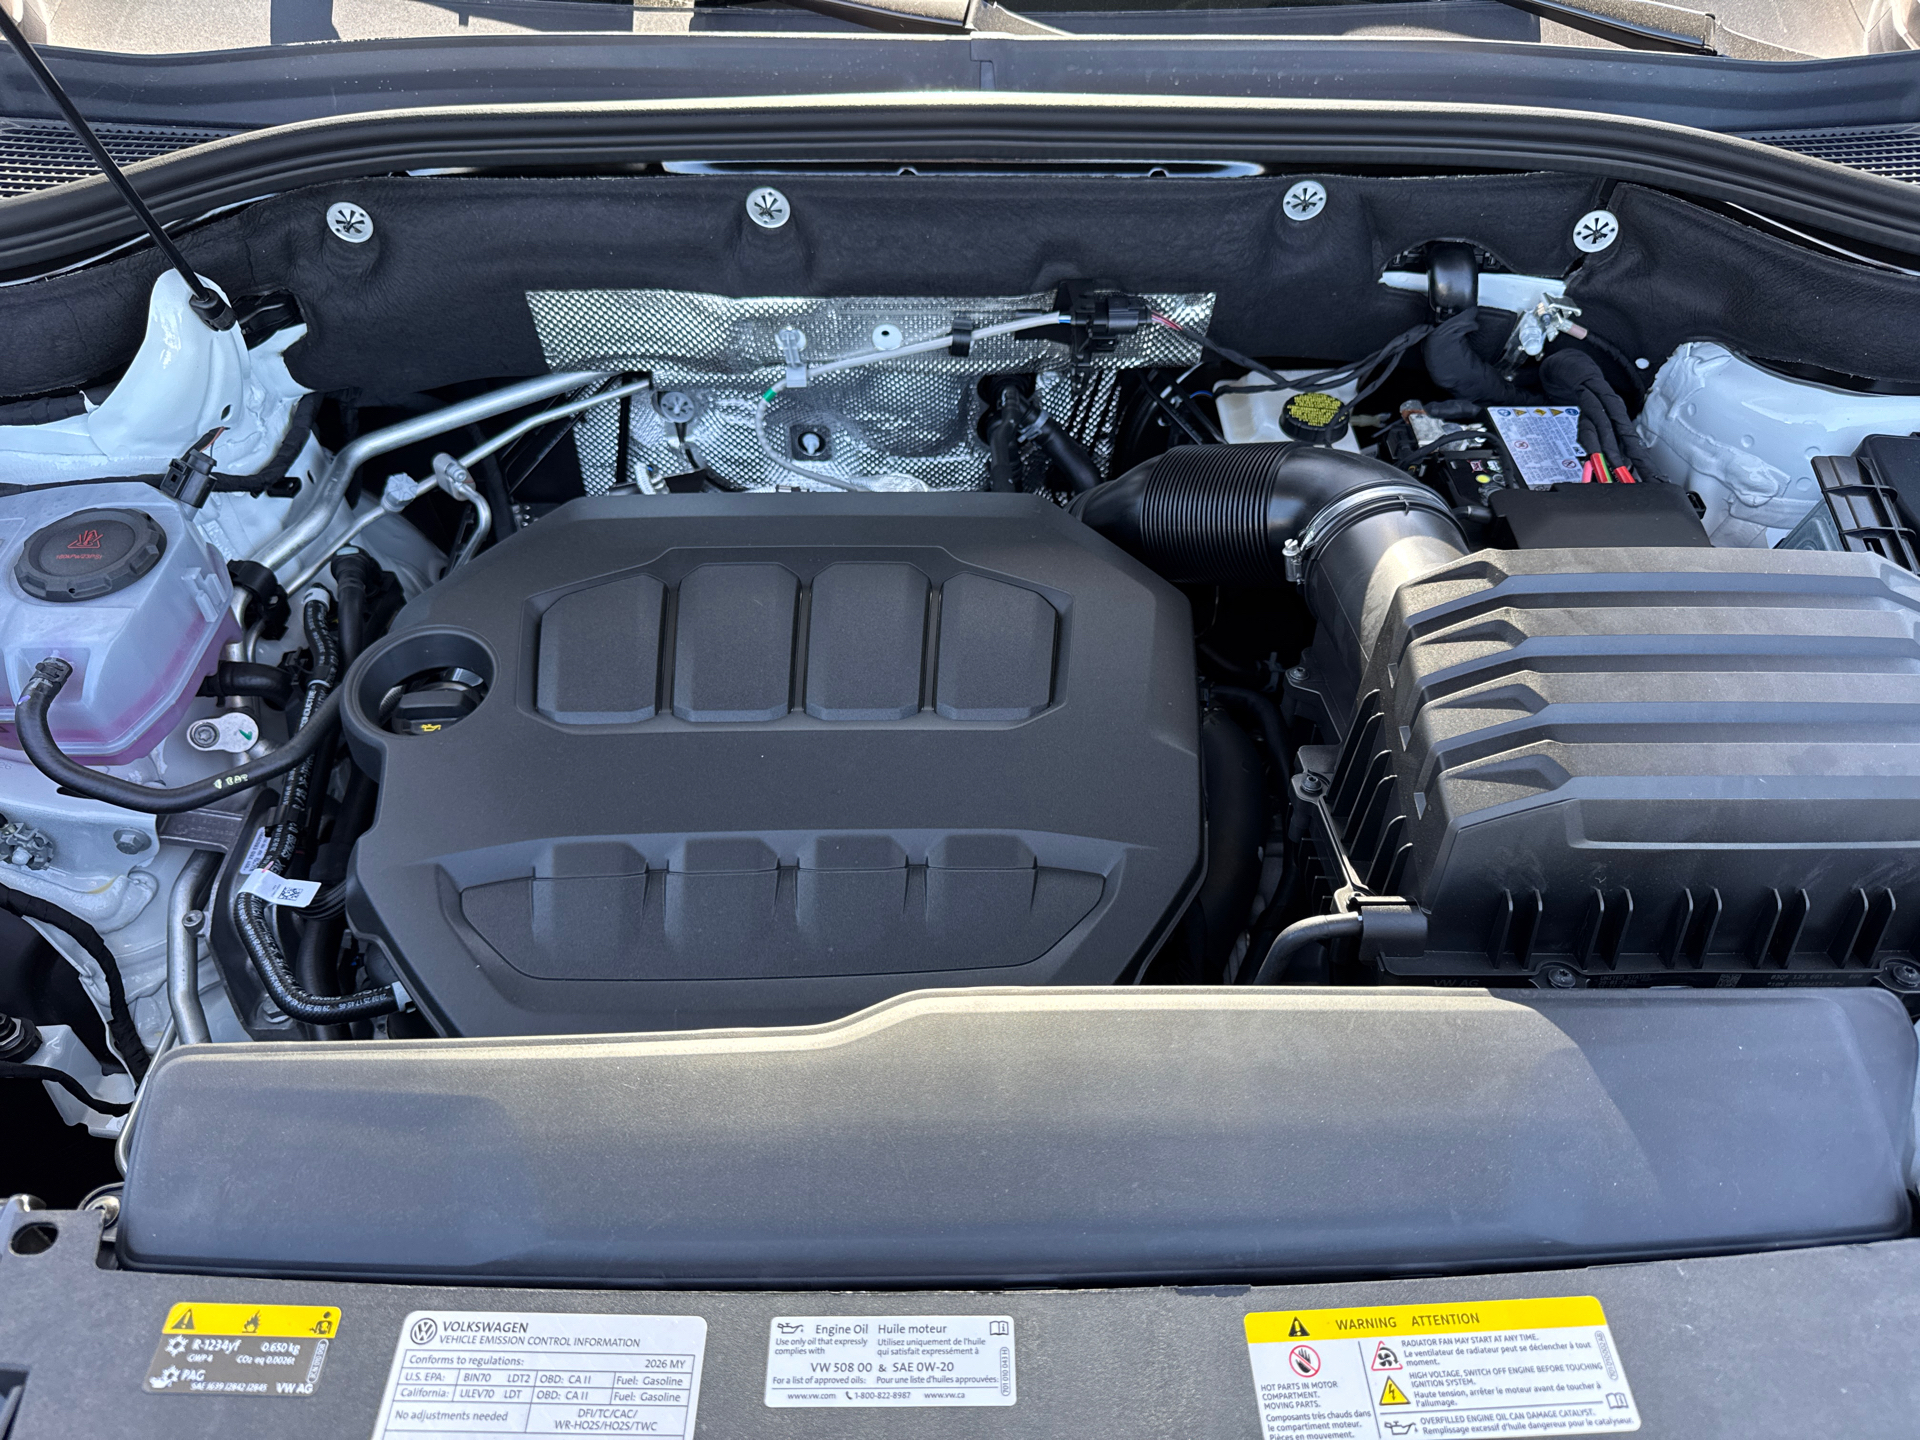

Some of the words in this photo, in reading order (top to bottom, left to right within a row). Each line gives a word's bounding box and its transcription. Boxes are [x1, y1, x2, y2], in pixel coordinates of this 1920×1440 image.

[1434, 979, 1456, 987] VW
[1460, 979, 1480, 987] AG
[1335, 1316, 1397, 1330] WARNING
[1412, 1313, 1480, 1326] ATTENTION
[443, 1321, 529, 1333] VOLKSWAGEN
[815, 1324, 851, 1336] Engine
[853, 1323, 868, 1334] Oil
[878, 1323, 905, 1334] Huile
[908, 1324, 947, 1333] moteur
[439, 1334, 477, 1344] VEHICLE
[479, 1335, 525, 1345] EMISSION
[527, 1336, 571, 1346] CONTROL
[573, 1337, 640, 1347] INFORMATION
[790, 1337, 806, 1347] only
[806, 1337, 816, 1345] oil
[817, 1337, 833, 1345] that
[833, 1337, 868, 1347] expressly
[877, 1338, 905, 1346] Utilisez
[906, 1338, 951, 1347] uniquement
[952, 1337, 962, 1345] de
[1401, 1338, 1437, 1347] RADIATOR
[1470, 1335, 1492, 1343] START
[192, 1338, 241, 1354] R-1234yf
[261, 1342, 288, 1352] 0.650
[289, 1343, 300, 1355] kg
[774, 1347, 807, 1356] complies
[808, 1346, 825, 1354] with
[876, 1347, 889, 1357] qui
[890, 1347, 920, 1355] satisfait
[921, 1347, 973, 1356] expressément
[974, 1346, 979, 1354] à
[1414, 1348, 1453, 1356] ventilateur
[1455, 1347, 1464, 1355] de
[1466, 1346, 1499, 1354] radiateur
[1500, 1345, 1518, 1354] peut
[1529, 1342, 1567, 1350] déclencher
[409, 1354, 454, 1364] Conforms
[456, 1355, 466, 1364] to
[468, 1355, 524, 1367] regulations:
[644, 1358, 667, 1368] 2026
[669, 1359, 686, 1368] MY
[1406, 1358, 1440, 1366] moment.
[810, 1362, 831, 1372] VW
[833, 1362, 854, 1372] 508
[857, 1362, 872, 1372] 00
[878, 1363, 886, 1372] &
[892, 1362, 913, 1372] SAE
[1428, 1369, 1462, 1378] VOLTAGE,
[1463, 1368, 1491, 1376] SWITCH
[1492, 1367, 1506, 1375] OFF
[1508, 1365, 1535, 1374] ENGINE
[1536, 1364, 1564, 1372] BEFORE
[1565, 1362, 1603, 1371] TOUCHING
[181, 1369, 206, 1381] PAG
[404, 1371, 422, 1381] U.S.
[424, 1372, 445, 1381] EPA:
[463, 1372, 491, 1382] BIN70
[506, 1373, 530, 1383] LDT2
[539, 1374, 564, 1384] OBD:
[568, 1374, 582, 1384] CA
[616, 1375, 638, 1385] Fuel:
[642, 1375, 683, 1386] Gasoline
[772, 1376, 784, 1384] For
[792, 1375, 804, 1384] list
[804, 1375, 814, 1384] of
[813, 1375, 849, 1385] approved
[850, 1375, 866, 1384] oils:
[876, 1375, 893, 1384] Pour
[909, 1375, 925, 1383] liste
[277, 1382, 296, 1393] VW
[296, 1382, 315, 1394] AG
[1260, 1383, 1275, 1391] HOT
[1277, 1382, 1300, 1390] PARTS
[1311, 1380, 1338, 1388] MOTOR
[1411, 1379, 1444, 1388] IGNITION
[1445, 1378, 1476, 1386] SYSTEM.
[400, 1387, 449, 1397] California:
[459, 1388, 495, 1398] ULEV70
[503, 1389, 522, 1399] LDT
[1469, 1387, 1494, 1396] arrêter
[1495, 1386, 1503, 1394] le
[1555, 1383, 1565, 1391] de
[1566, 1382, 1594, 1390] toucher
[536, 1390, 561, 1400] OBD:
[565, 1390, 579, 1400] CA
[613, 1391, 636, 1401] Fuel:
[639, 1391, 681, 1402] Gasoline
[854, 1391, 911, 1399] 1-800-822-8987
[1262, 1390, 1320, 1400] COMPARTMENT.
[1264, 1401, 1294, 1409] MOVING
[1295, 1400, 1321, 1408] PARTS.
[394, 1410, 409, 1419] No
[410, 1410, 470, 1420] adjustments
[472, 1411, 508, 1421] needed
[1266, 1413, 1311, 1422] Composants
[1311, 1411, 1326, 1419] très
[1327, 1410, 1353, 1419] chauds
[1353, 1409, 1371, 1417] dans
[1420, 1415, 1465, 1425] OVERFILLED
[1466, 1413, 1494, 1422] ENGINE
[1495, 1413, 1509, 1421] OIL
[1509, 1412, 1525, 1420] CAN
[1526, 1410, 1558, 1419] DAMAGE
[1558, 1408, 1595, 1417] CATALYST.
[1267, 1424, 1275, 1432] le
[1276, 1422, 1330, 1431] compartiment
[1422, 1425, 1469, 1435] Remplissage
[1471, 1423, 1500, 1432] excessif
[1528, 1421, 1566, 1430] dangereux
[1568, 1420, 1584, 1428] pour
[1306, 1431, 1354, 1440] mouvement.
